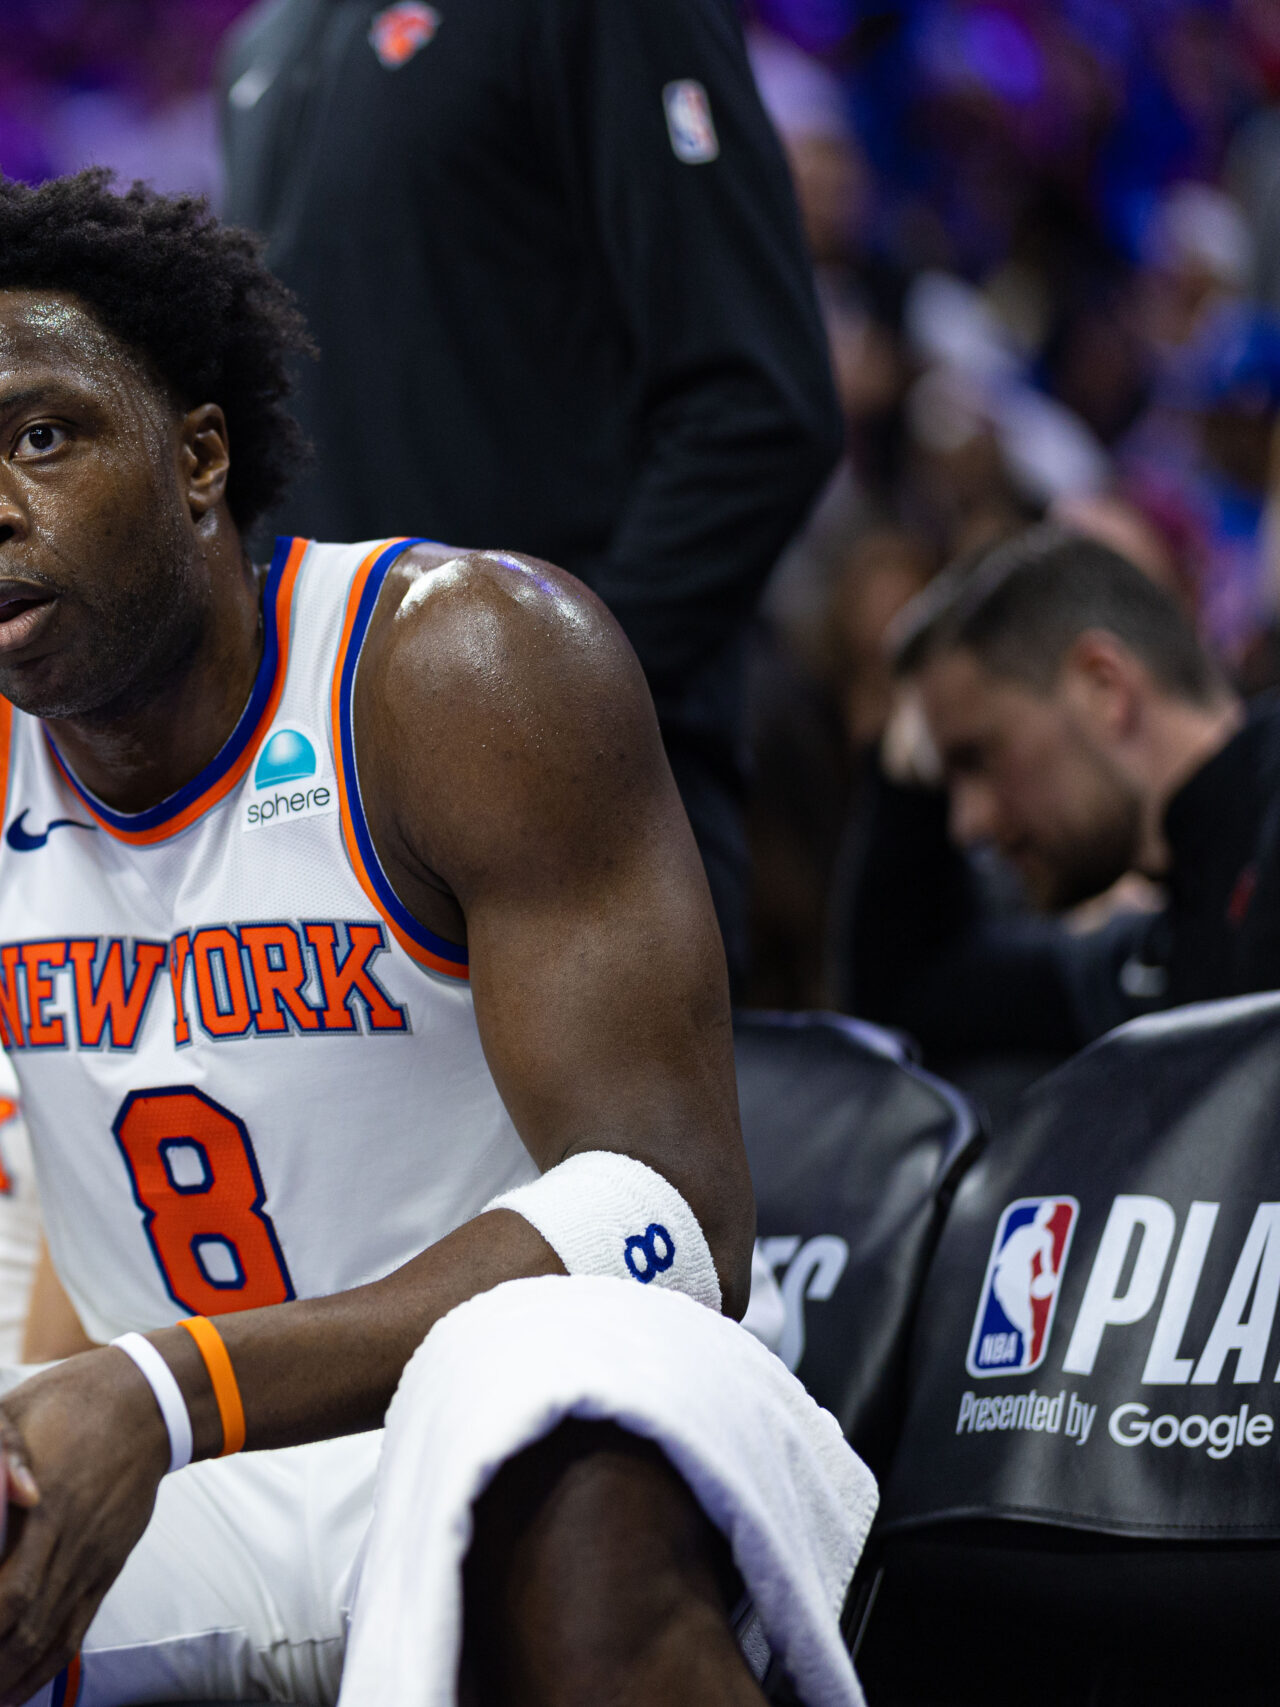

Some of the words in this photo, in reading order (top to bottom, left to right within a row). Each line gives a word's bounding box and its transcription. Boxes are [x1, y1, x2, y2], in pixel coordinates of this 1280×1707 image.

[247, 787, 330, 825] sphere
[169, 918, 413, 1052] YORK
[111, 1084, 297, 1318] 8
[624, 1223, 676, 1284] 8
[1061, 1194, 1280, 1386] PLA
[978, 1331, 1019, 1367] NBA
[955, 1389, 1067, 1436] Presented
[1065, 1392, 1098, 1446] by
[1108, 1401, 1275, 1460] Google
